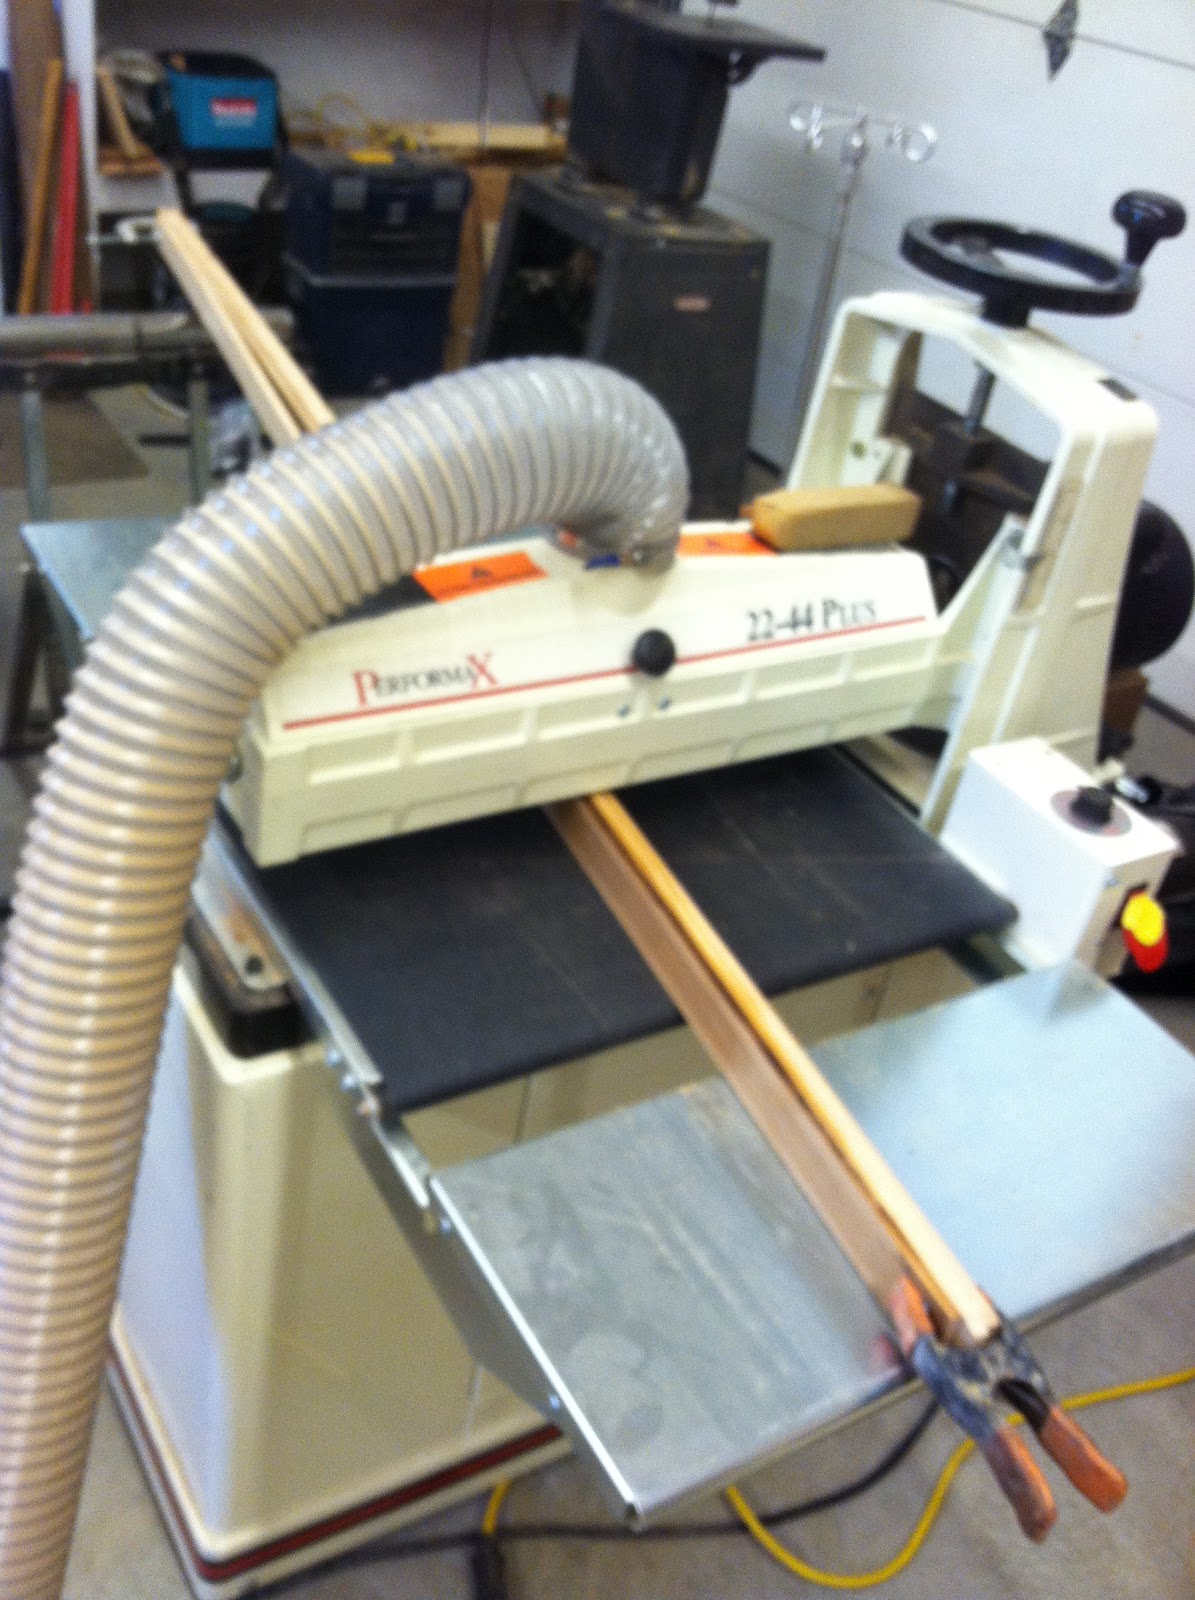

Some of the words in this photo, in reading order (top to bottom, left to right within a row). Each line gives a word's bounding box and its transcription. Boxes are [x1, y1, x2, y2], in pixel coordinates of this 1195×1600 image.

[747, 602, 813, 642] 22-44
[821, 598, 876, 630] PLUS
[353, 651, 498, 707] PERFORMAX
